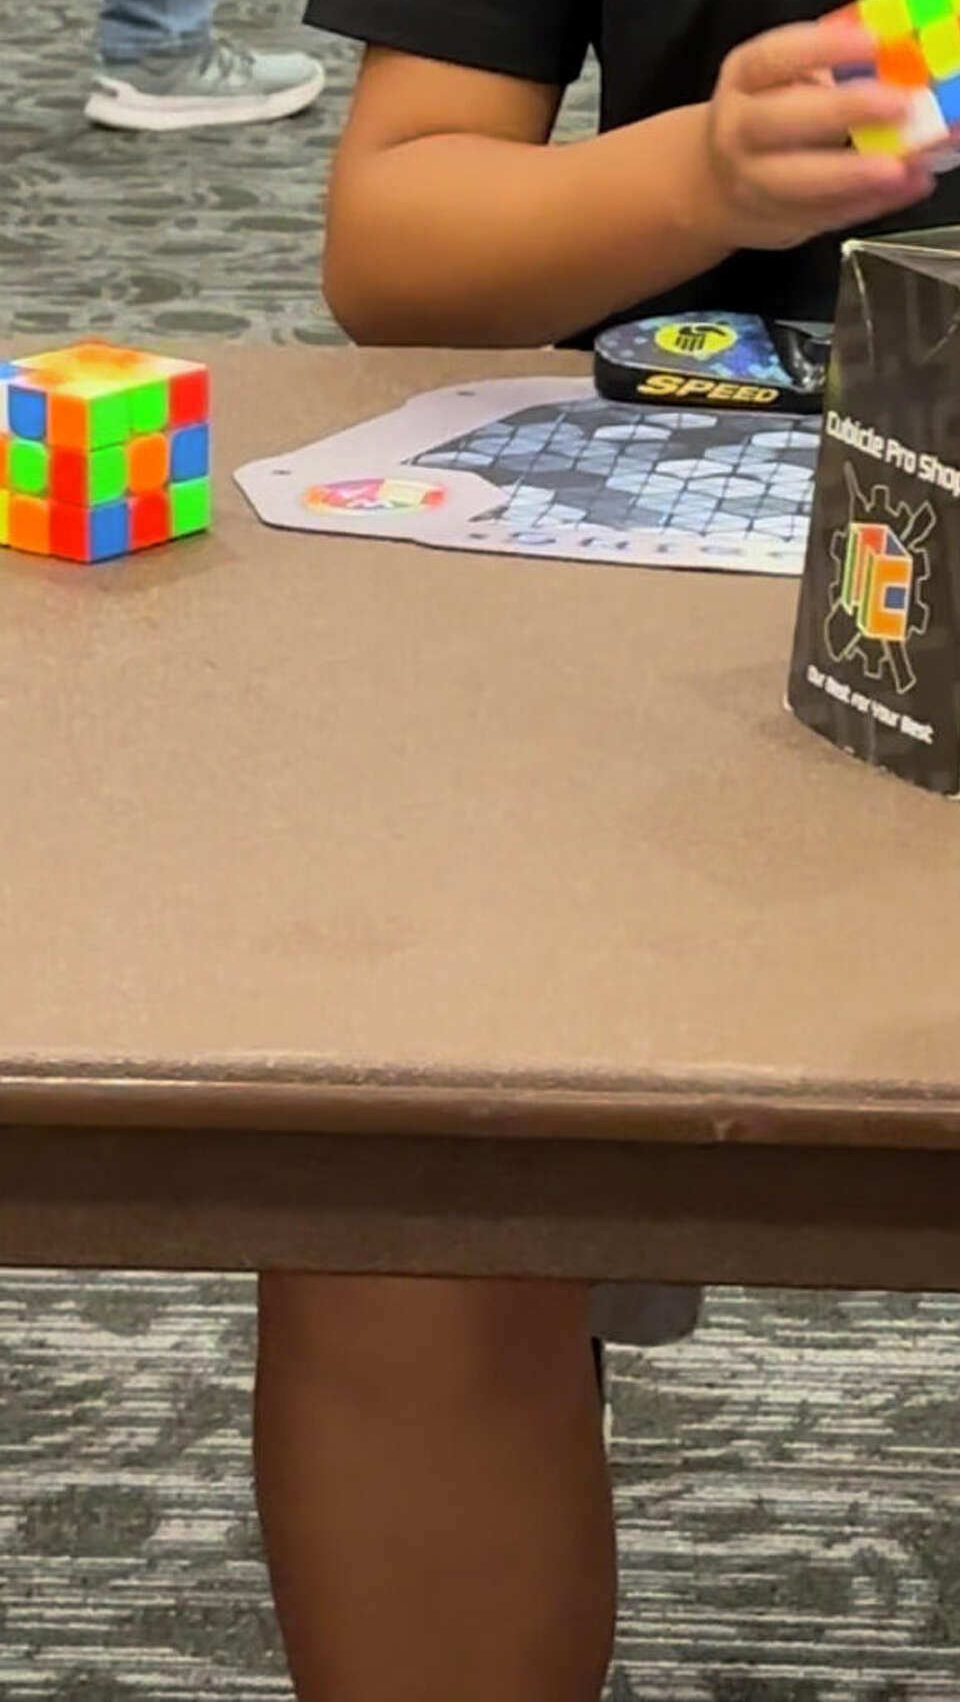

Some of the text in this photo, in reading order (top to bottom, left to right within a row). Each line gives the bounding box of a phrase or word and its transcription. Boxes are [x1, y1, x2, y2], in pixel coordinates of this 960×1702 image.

[637, 374, 780, 404] SPEED
[826, 410, 884, 460] Cubicle
[885, 438, 917, 474] Pro
